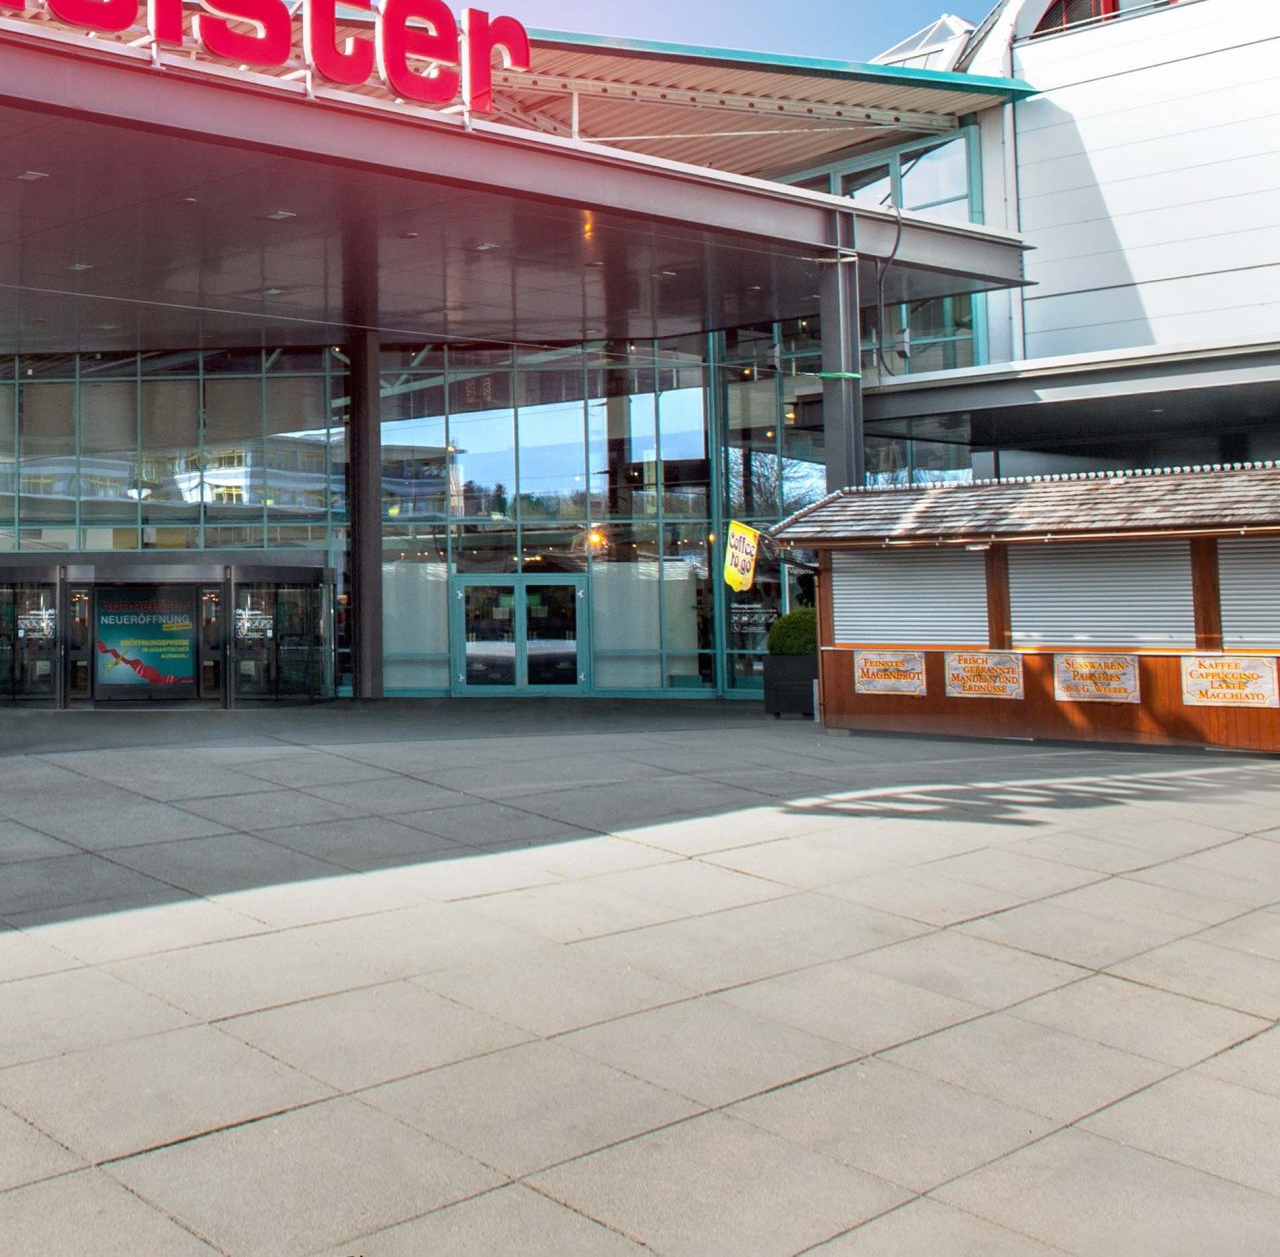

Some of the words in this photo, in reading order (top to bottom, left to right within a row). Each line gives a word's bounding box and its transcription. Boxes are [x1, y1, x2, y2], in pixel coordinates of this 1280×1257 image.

[729, 532, 755, 557] Coffee
[730, 552, 739, 568] to
[738, 559, 752, 575] go
[100, 614, 190, 624] NEUERÖFFNUNG
[864, 658, 905, 667] FEINSTES
[957, 655, 988, 665] FRISCH
[1198, 660, 1241, 670] KAFFEE
[861, 668, 922, 680] MAGENBROT
[1072, 671, 1121, 682] PARADIES
[999, 676, 1018, 684] UND
[1198, 690, 1265, 700] MACCHIATO
